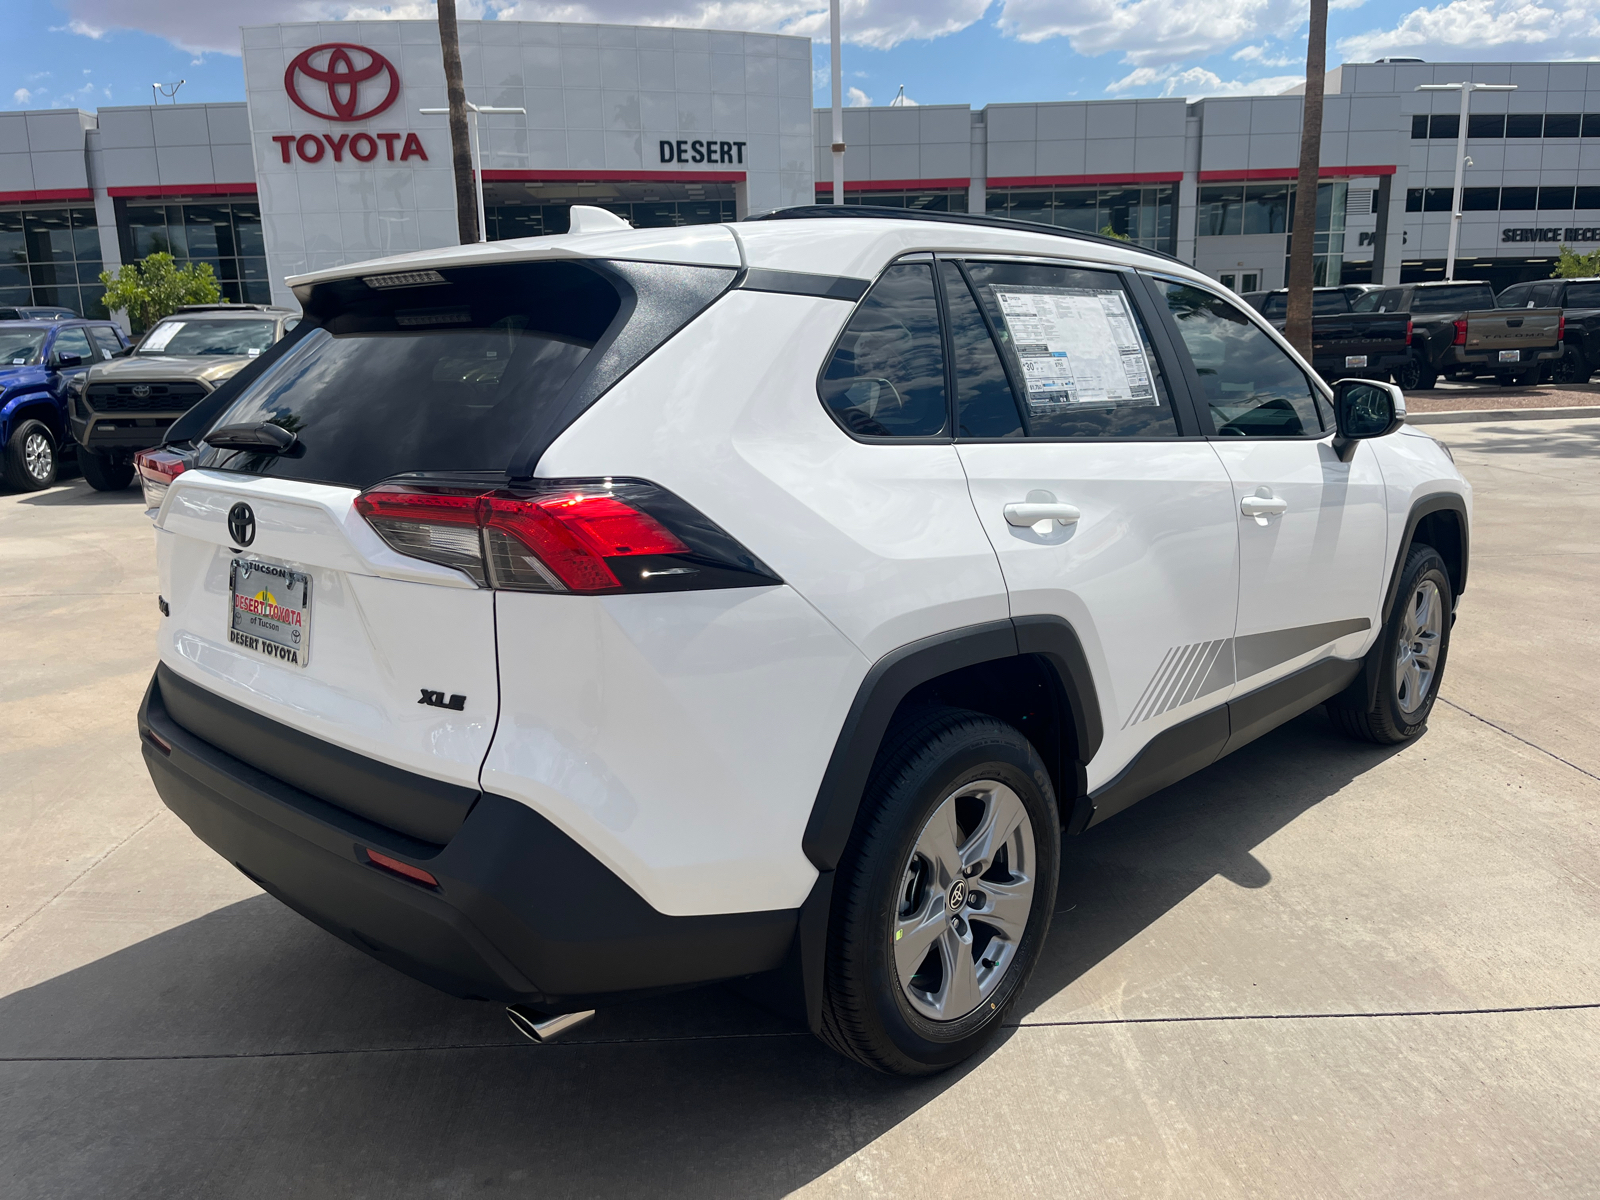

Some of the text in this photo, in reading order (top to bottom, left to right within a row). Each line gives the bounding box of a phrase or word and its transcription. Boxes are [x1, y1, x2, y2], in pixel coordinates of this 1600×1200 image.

[272, 132, 429, 164] TOYOTA
[659, 140, 747, 163] DESERT
[1502, 228, 1562, 243] SERVICE
[249, 561, 286, 578] TUCSON
[235, 594, 302, 628] DESERT TOYOTA
[250, 616, 280, 632] of Tucson
[230, 630, 298, 664] DESERT TOYOTA
[417, 688, 467, 711] XLE
